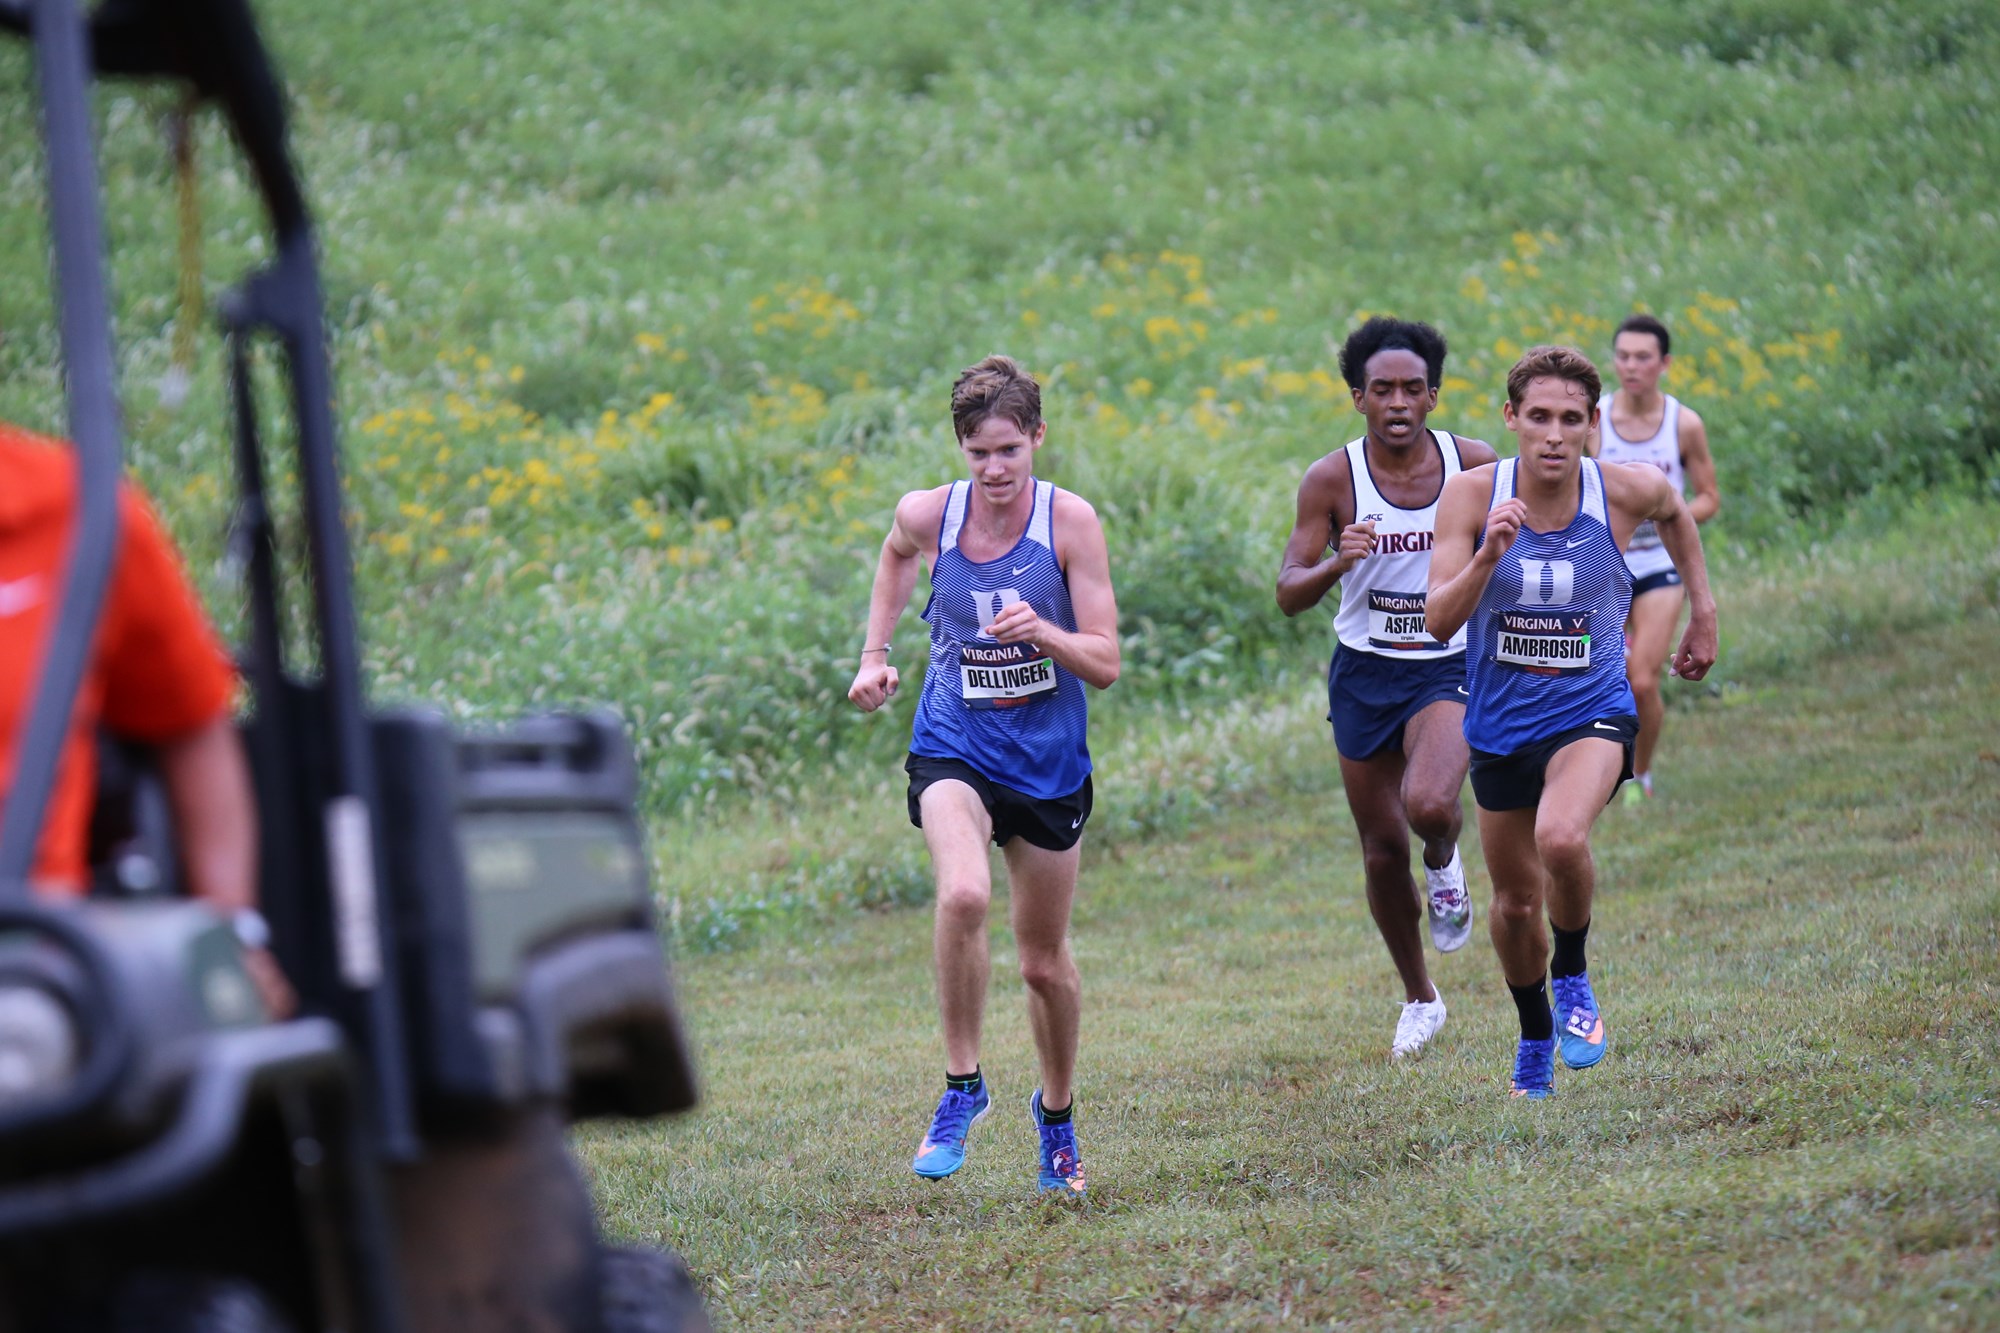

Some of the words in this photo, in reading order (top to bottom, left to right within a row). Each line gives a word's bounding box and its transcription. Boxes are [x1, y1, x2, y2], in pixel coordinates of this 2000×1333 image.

[1362, 513, 1384, 521] ACC
[1372, 595, 1426, 609] VIRGINIA
[1504, 615, 1562, 630] VIRGINIA
[962, 646, 1023, 661] VIRGINIA
[1502, 635, 1586, 659] AMBROSIO
[967, 662, 1049, 688] DELLINGER
